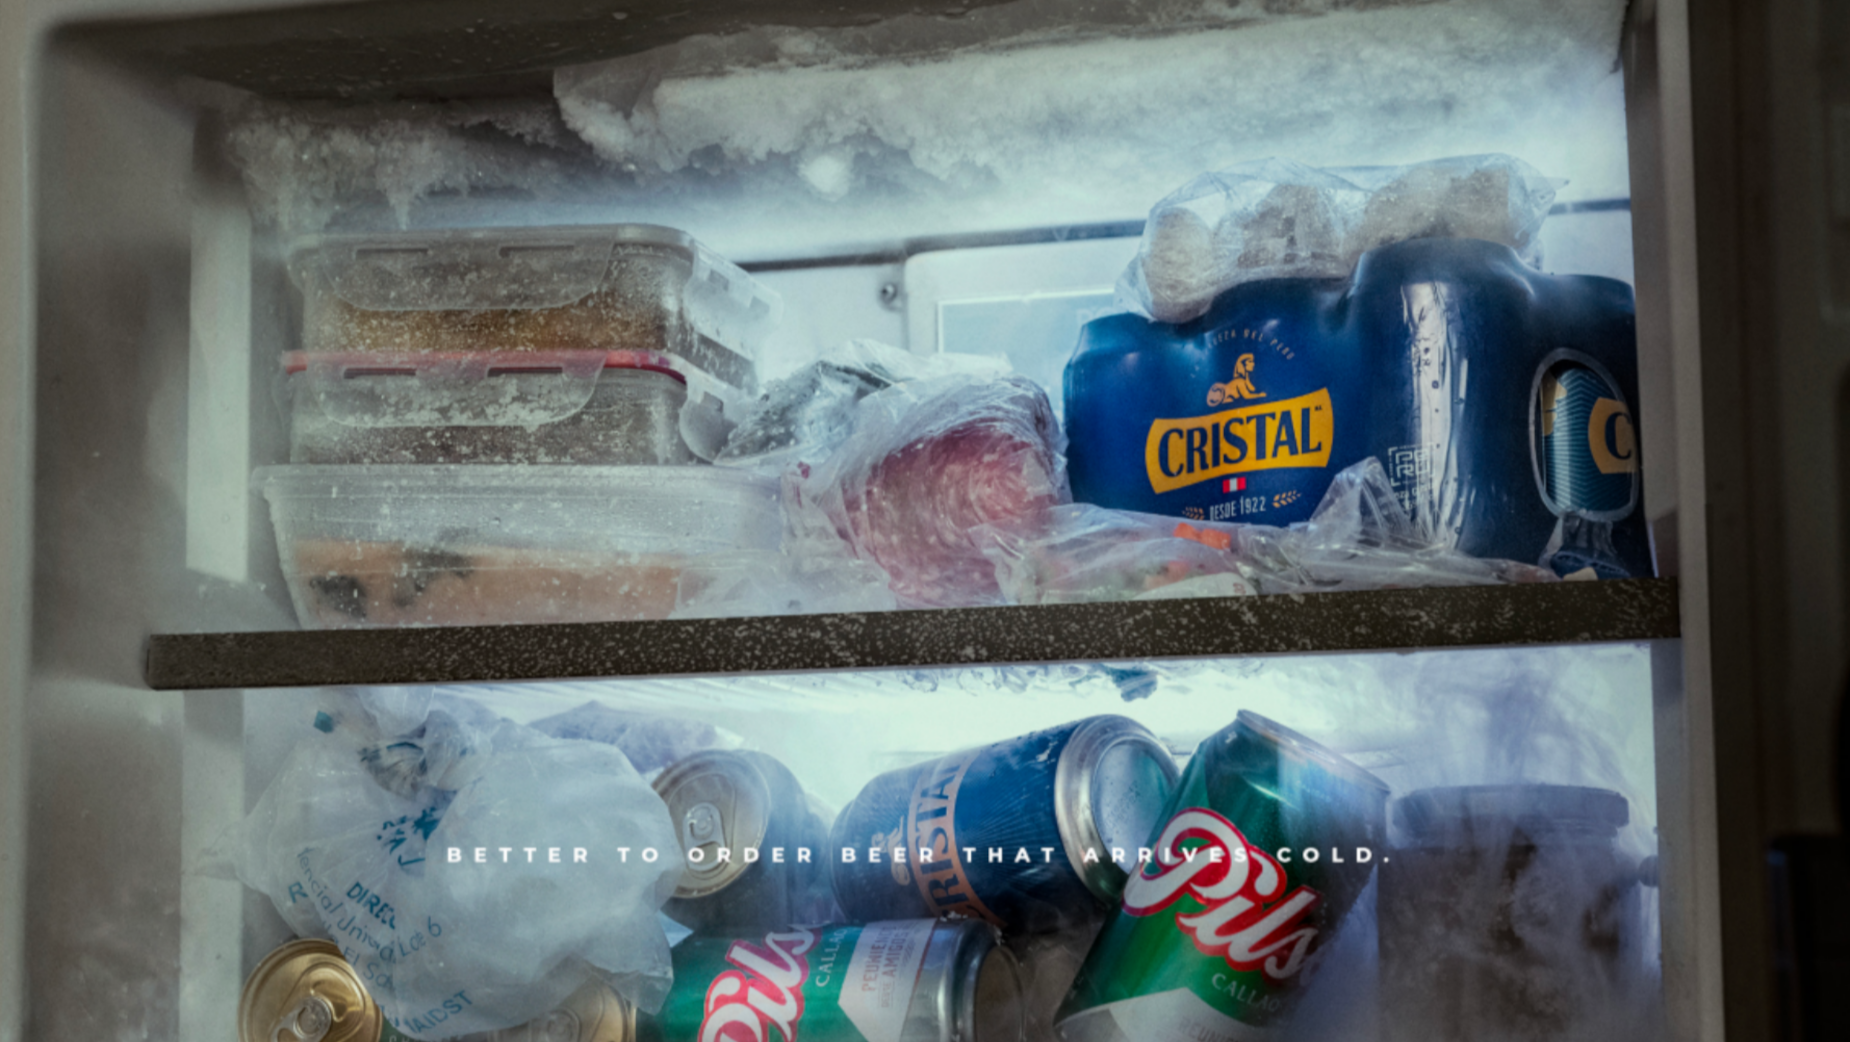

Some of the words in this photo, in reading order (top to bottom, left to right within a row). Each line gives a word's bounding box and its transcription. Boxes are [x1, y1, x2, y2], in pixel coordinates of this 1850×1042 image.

[1158, 406, 1322, 478] CRISTAL
[1239, 496, 1266, 515] 1922
[1212, 973, 1280, 1013] CALLAO
